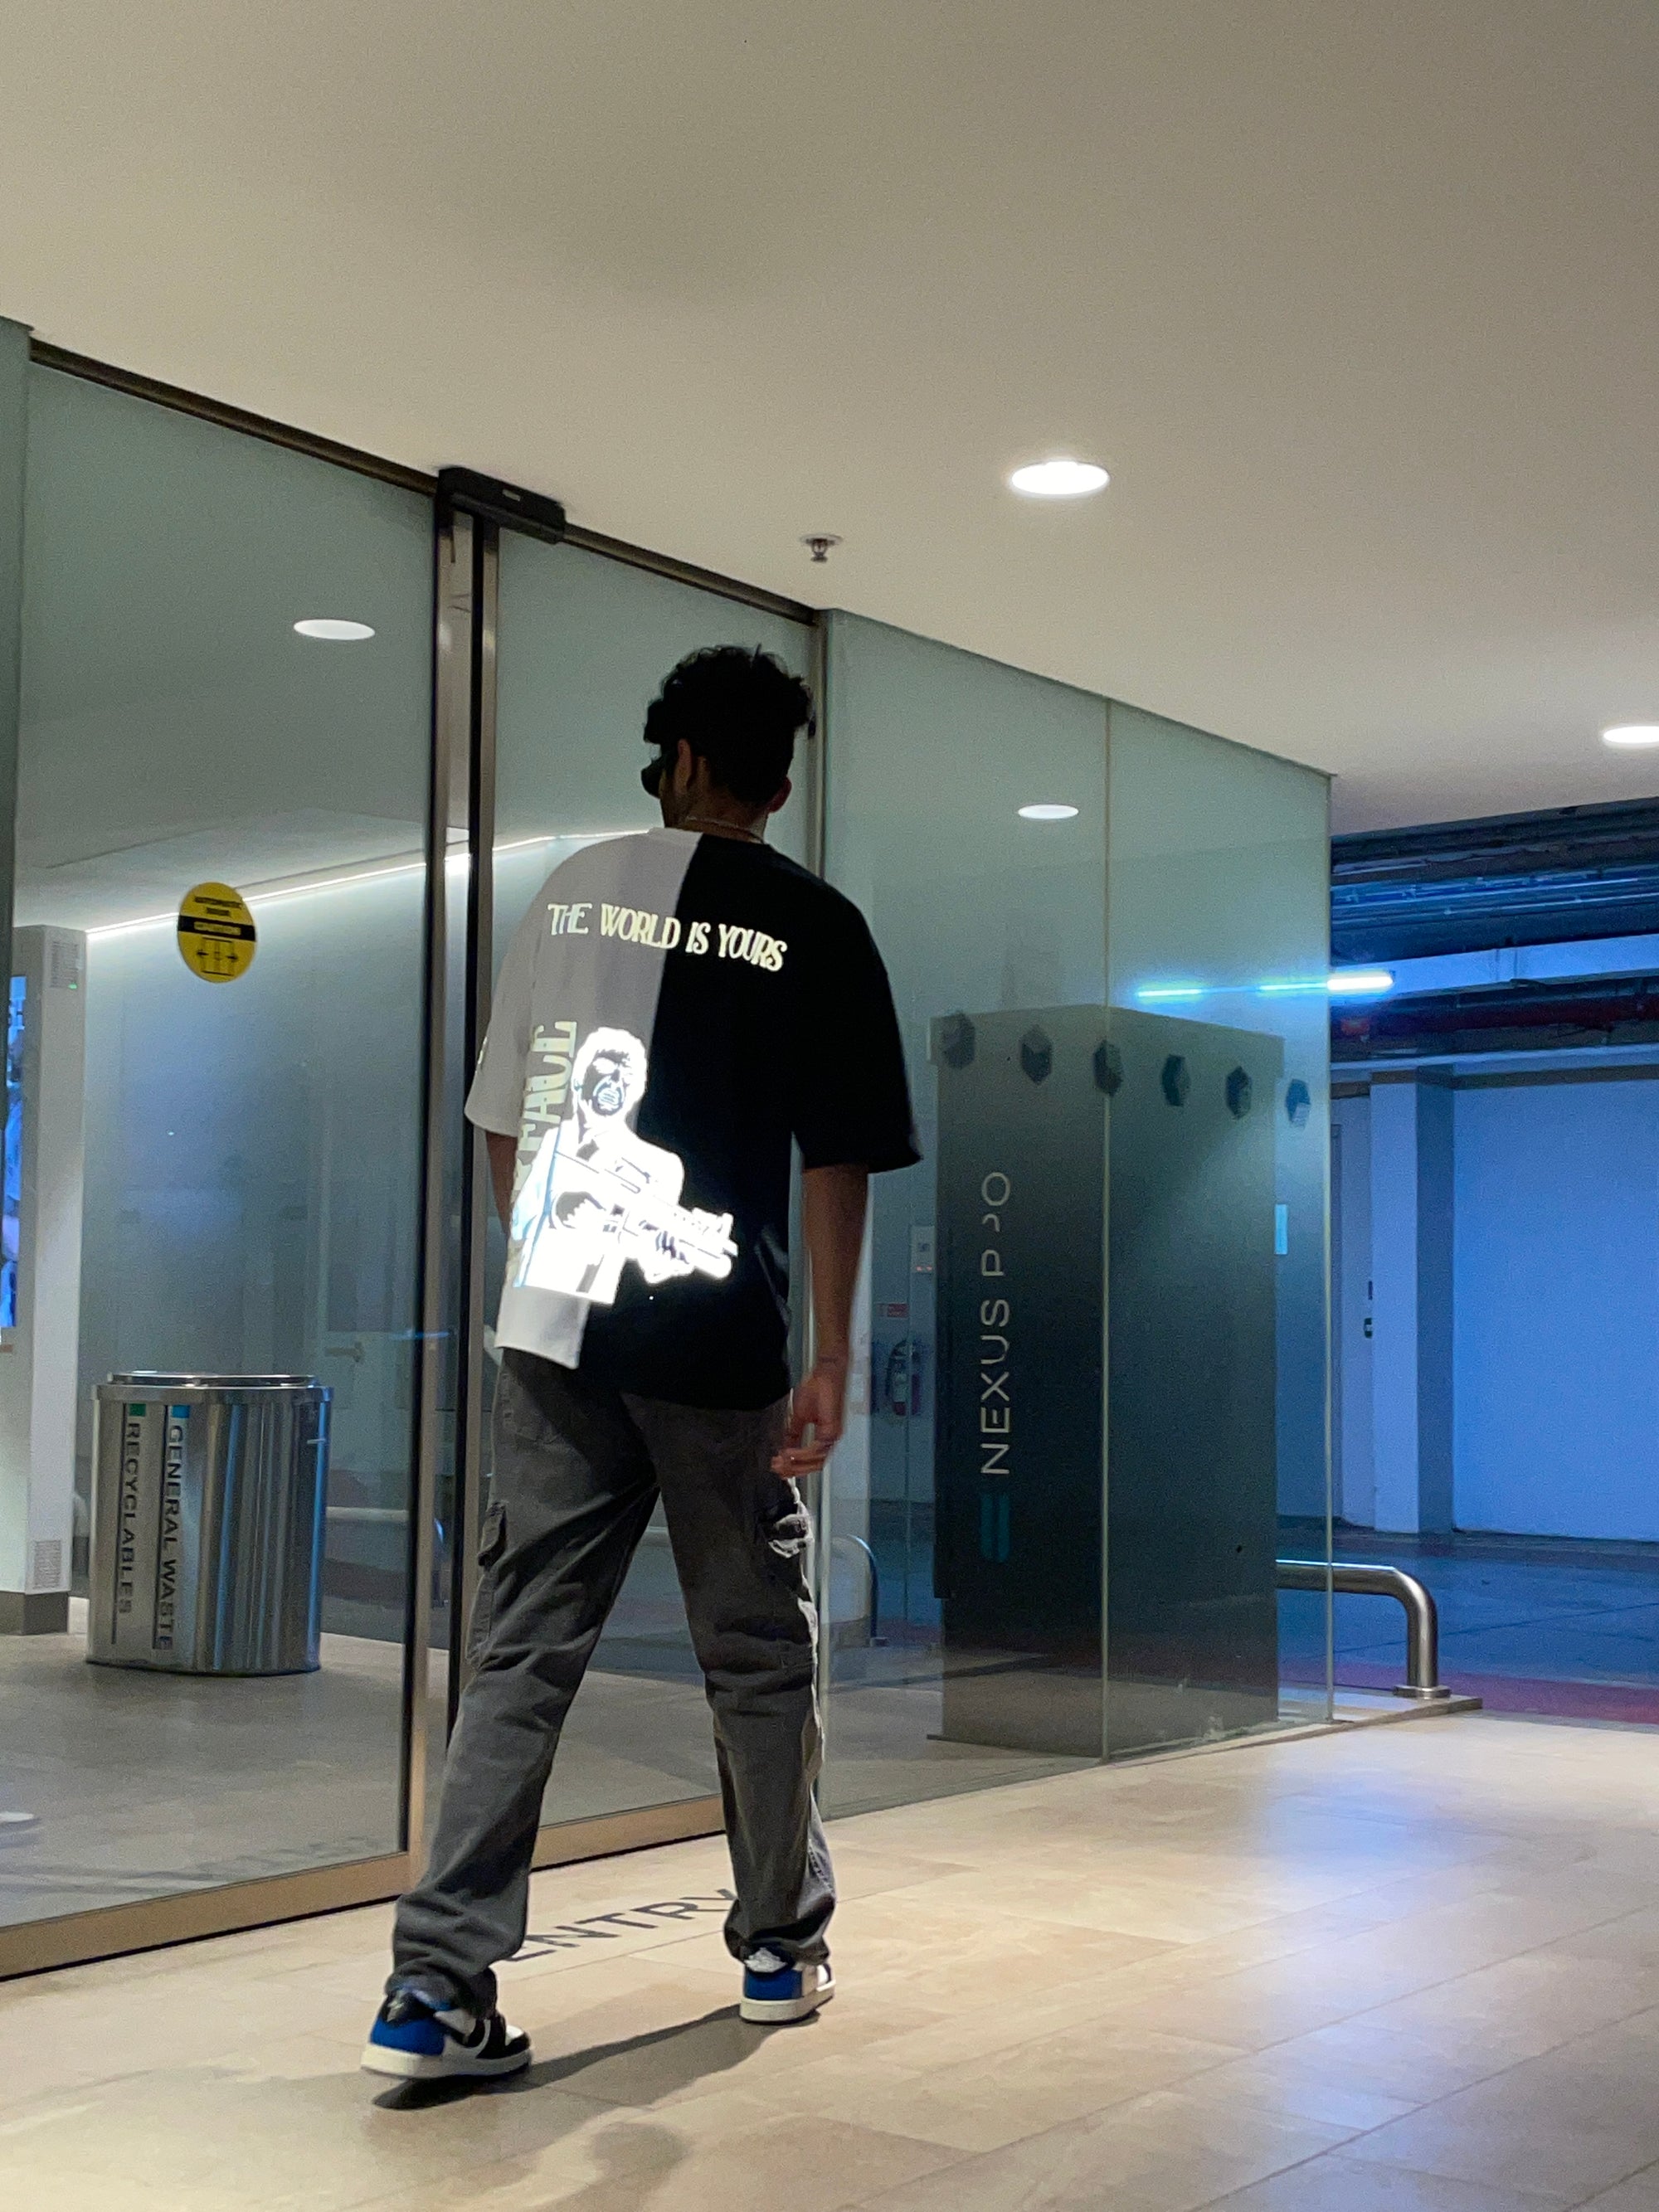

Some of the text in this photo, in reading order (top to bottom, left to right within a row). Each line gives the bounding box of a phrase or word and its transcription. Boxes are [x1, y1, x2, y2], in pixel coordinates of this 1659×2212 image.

[547, 903, 787, 972] THE WORLD IS YOURS
[980, 1299, 1010, 1475] NEXUS
[119, 1422, 140, 1613] RECYCLABLES
[158, 1425, 182, 1650] GENERAL WASTE
